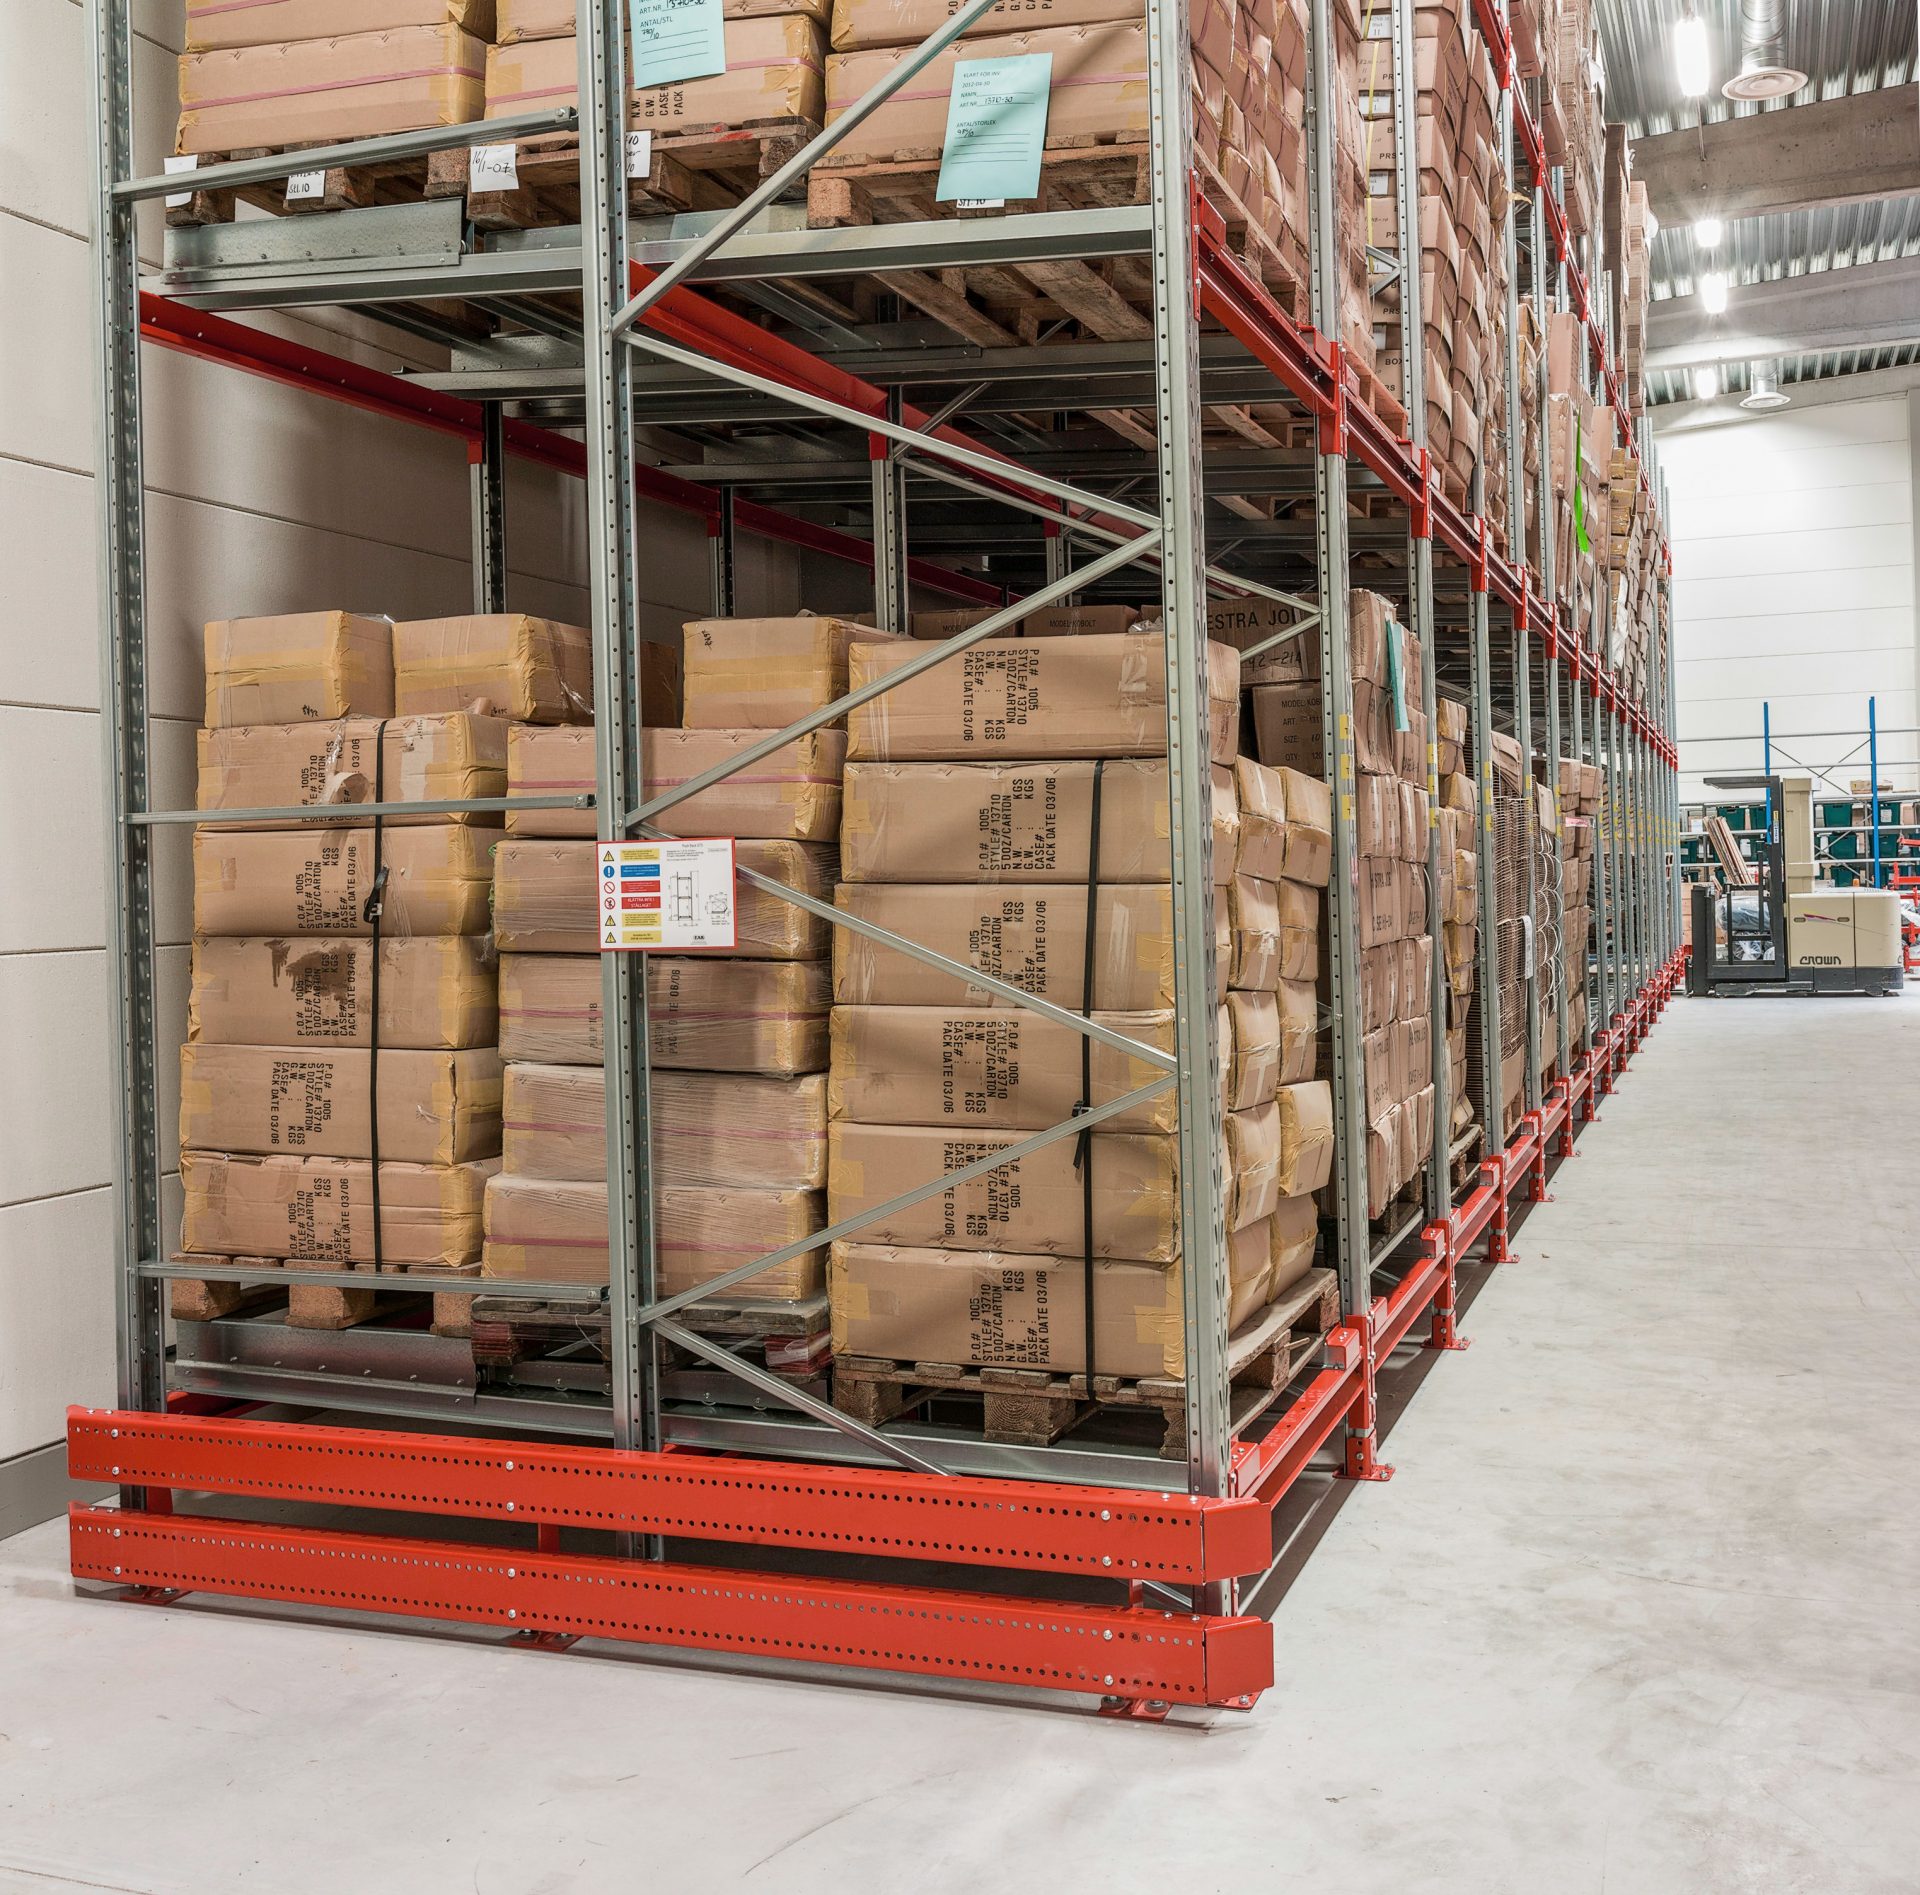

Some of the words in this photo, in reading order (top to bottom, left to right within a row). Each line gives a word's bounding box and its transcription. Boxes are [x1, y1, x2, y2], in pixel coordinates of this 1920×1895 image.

[631, 97, 640, 118] N.W.
[646, 96, 655, 117] G.W.
[674, 91, 683, 115] PACK
[964, 651, 974, 677] PACK
[974, 651, 985, 686] CASE#
[1018, 649, 1029, 690] STYLE#
[963, 681, 974, 706] DATE
[1028, 687, 1039, 711] 1005
[1017, 696, 1027, 725] 13710
[963, 710, 974, 741] 03/06
[984, 719, 994, 740] KGS
[995, 719, 1006, 740] KGS
[352, 739, 360, 768] 03/06
[310, 755, 318, 781] 13710
[1013, 778, 1023, 800] KGS
[1024, 779, 1034, 800] KGS
[1046, 778, 1056, 810] 03/06
[980, 808, 990, 831] 1005
[991, 794, 1001, 822] 13710
[1046, 814, 1056, 839] DATE
[322, 848, 330, 866] KGS
[331, 848, 339, 866] KGS
[348, 846, 356, 875] 03/06
[990, 829, 1000, 870] STYLE#
[1035, 834, 1045, 870] CASE#
[1046, 843, 1056, 870] PACK
[296, 874, 304, 894] 1005
[305, 861, 313, 886] 13710
[347, 878, 356, 901] DATE
[305, 892, 314, 929] STYLE#
[340, 897, 349, 928] CASE#
[348, 903, 358, 928] PACK
[1003, 901, 1013, 922] KGS
[1014, 902, 1024, 922] KGS
[1036, 901, 1046, 933] 03/06
[970, 930, 979, 953] 1005
[981, 916, 991, 945] 13710
[1036, 937, 1046, 962] DATE
[1800, 956, 1841, 965] CROWN
[322, 954, 330, 972] KGS
[330, 954, 338, 973] KGS
[347, 953, 356, 983] 03/06
[1025, 957, 1036, 992] CASE#
[296, 980, 304, 1001] 1005
[305, 967, 313, 994] 13710
[1036, 966, 1046, 993] PACK
[348, 986, 356, 1009] DATE
[305, 998, 314, 1036] STYLE#
[339, 1004, 348, 1036] CASE#
[348, 1012, 356, 1036] PACK
[943, 1021, 952, 1047] PACK
[954, 1021, 963, 1057] CASE#
[997, 1021, 1008, 1064] STYLE#
[272, 1061, 281, 1085] PACK
[943, 1051, 953, 1077] DATE
[1009, 1061, 1018, 1085] 1005
[280, 1062, 290, 1094] CASE#
[314, 1063, 324, 1101] STYLE#
[997, 1070, 1008, 1099] 13710
[271, 1089, 279, 1112] DATE
[323, 1099, 331, 1120] 1005
[943, 1081, 954, 1113] 03/06
[965, 1092, 975, 1113] KGS
[976, 1092, 986, 1113] KGS
[270, 1115, 279, 1144] 03/06
[314, 1106, 322, 1133] 13710
[288, 1126, 296, 1144] KGS
[297, 1126, 305, 1145] KGS
[944, 1143, 954, 1170] PACK
[314, 1178, 322, 1197] KGS
[323, 1178, 331, 1198] KGS
[340, 1178, 349, 1208] 03/06
[1010, 1184, 1020, 1208] 1005
[288, 1203, 297, 1224] 1005
[297, 1190, 305, 1217] 13710
[999, 1192, 1010, 1222] 13710
[944, 1203, 955, 1235] 03/06
[966, 1214, 976, 1236] KGS
[977, 1215, 988, 1236] KGS
[298, 1222, 308, 1259] STYLE#
[334, 1228, 343, 1260] CASE#
[342, 1237, 351, 1260] PACK
[1003, 1270, 1013, 1291] KGS
[1014, 1271, 1024, 1292] KGS
[1036, 1270, 1047, 1303] 03/06
[970, 1298, 980, 1321] 1005
[981, 1284, 991, 1313] 13710
[1038, 1307, 1048, 1333] DATE
[982, 1319, 993, 1361] STYLE#
[1027, 1328, 1038, 1363] CASE#
[1039, 1338, 1050, 1364] PACK
